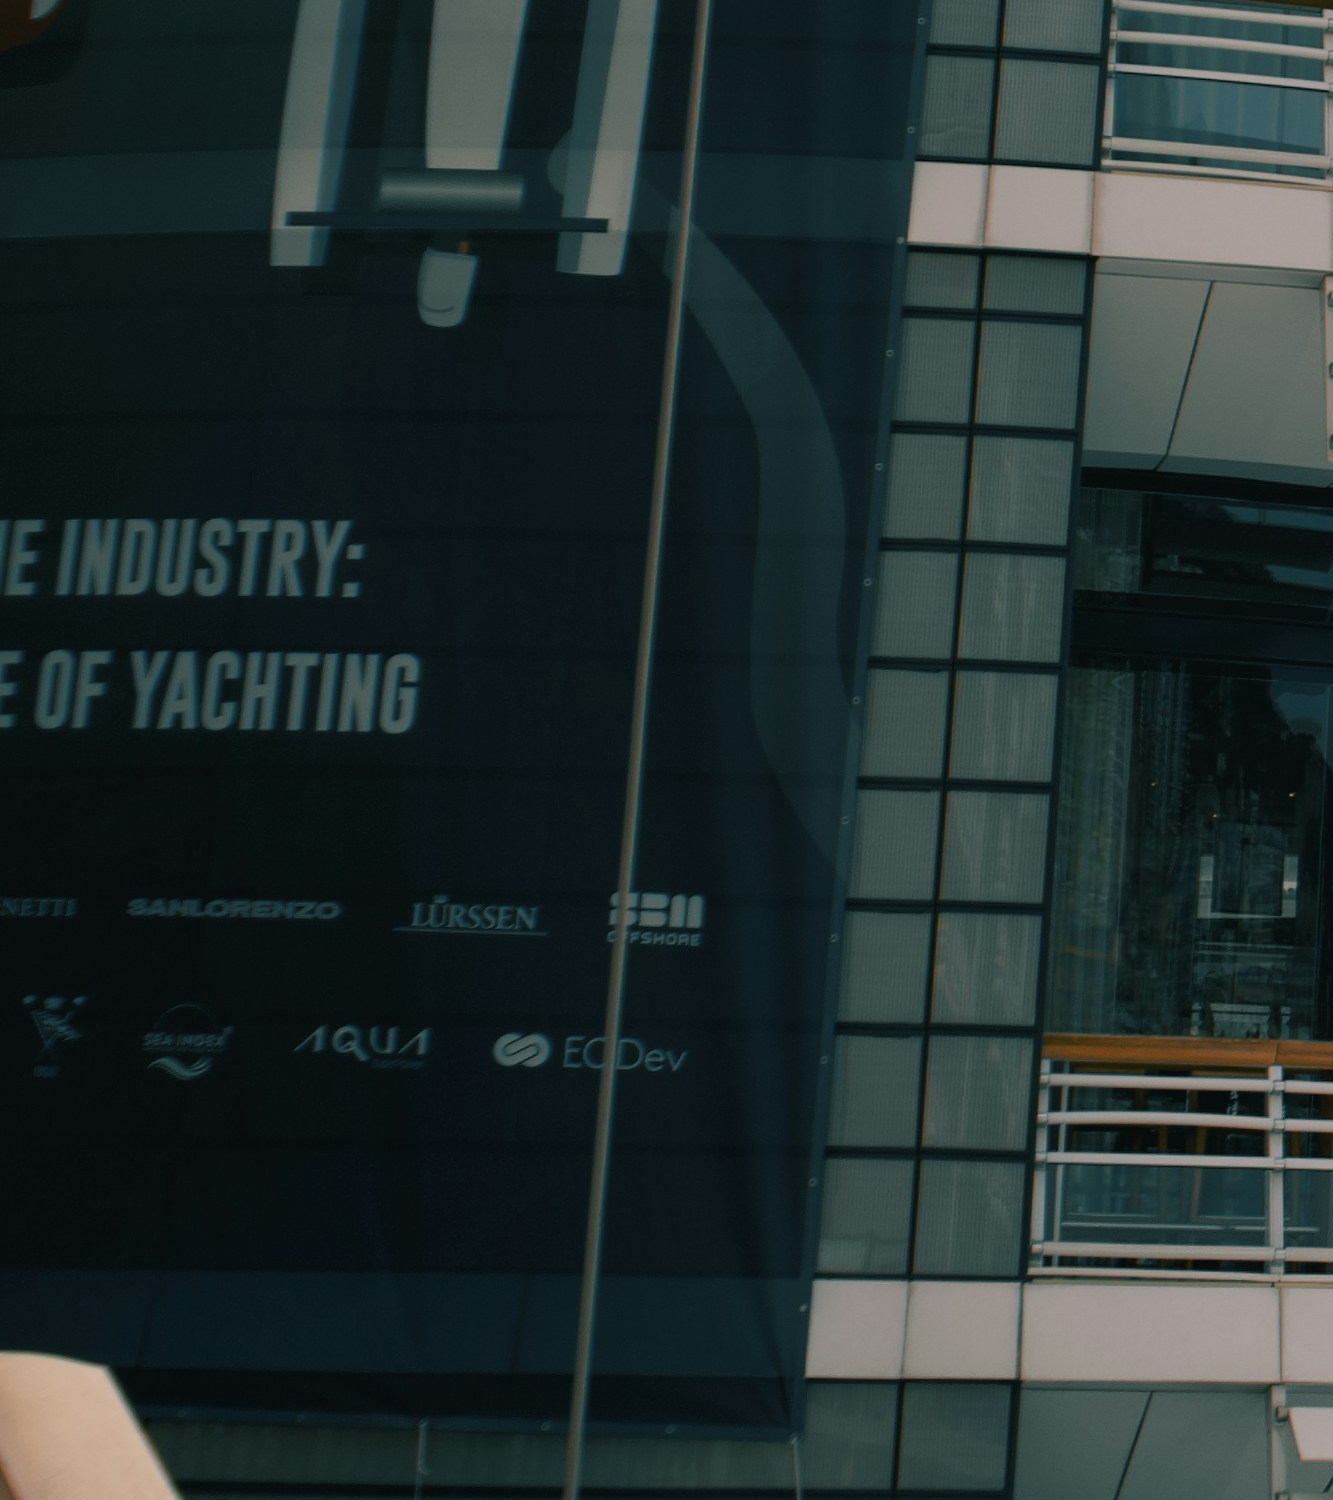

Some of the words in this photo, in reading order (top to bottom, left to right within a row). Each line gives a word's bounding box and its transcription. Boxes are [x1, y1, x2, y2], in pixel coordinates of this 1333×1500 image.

[0, 517, 48, 597] E
[54, 517, 368, 599] INDUSTRY:
[33, 648, 115, 731] OF
[129, 649, 424, 735] YACHTING
[127, 898, 342, 920] SANLORENZO
[409, 894, 542, 931] LÜRSSEN
